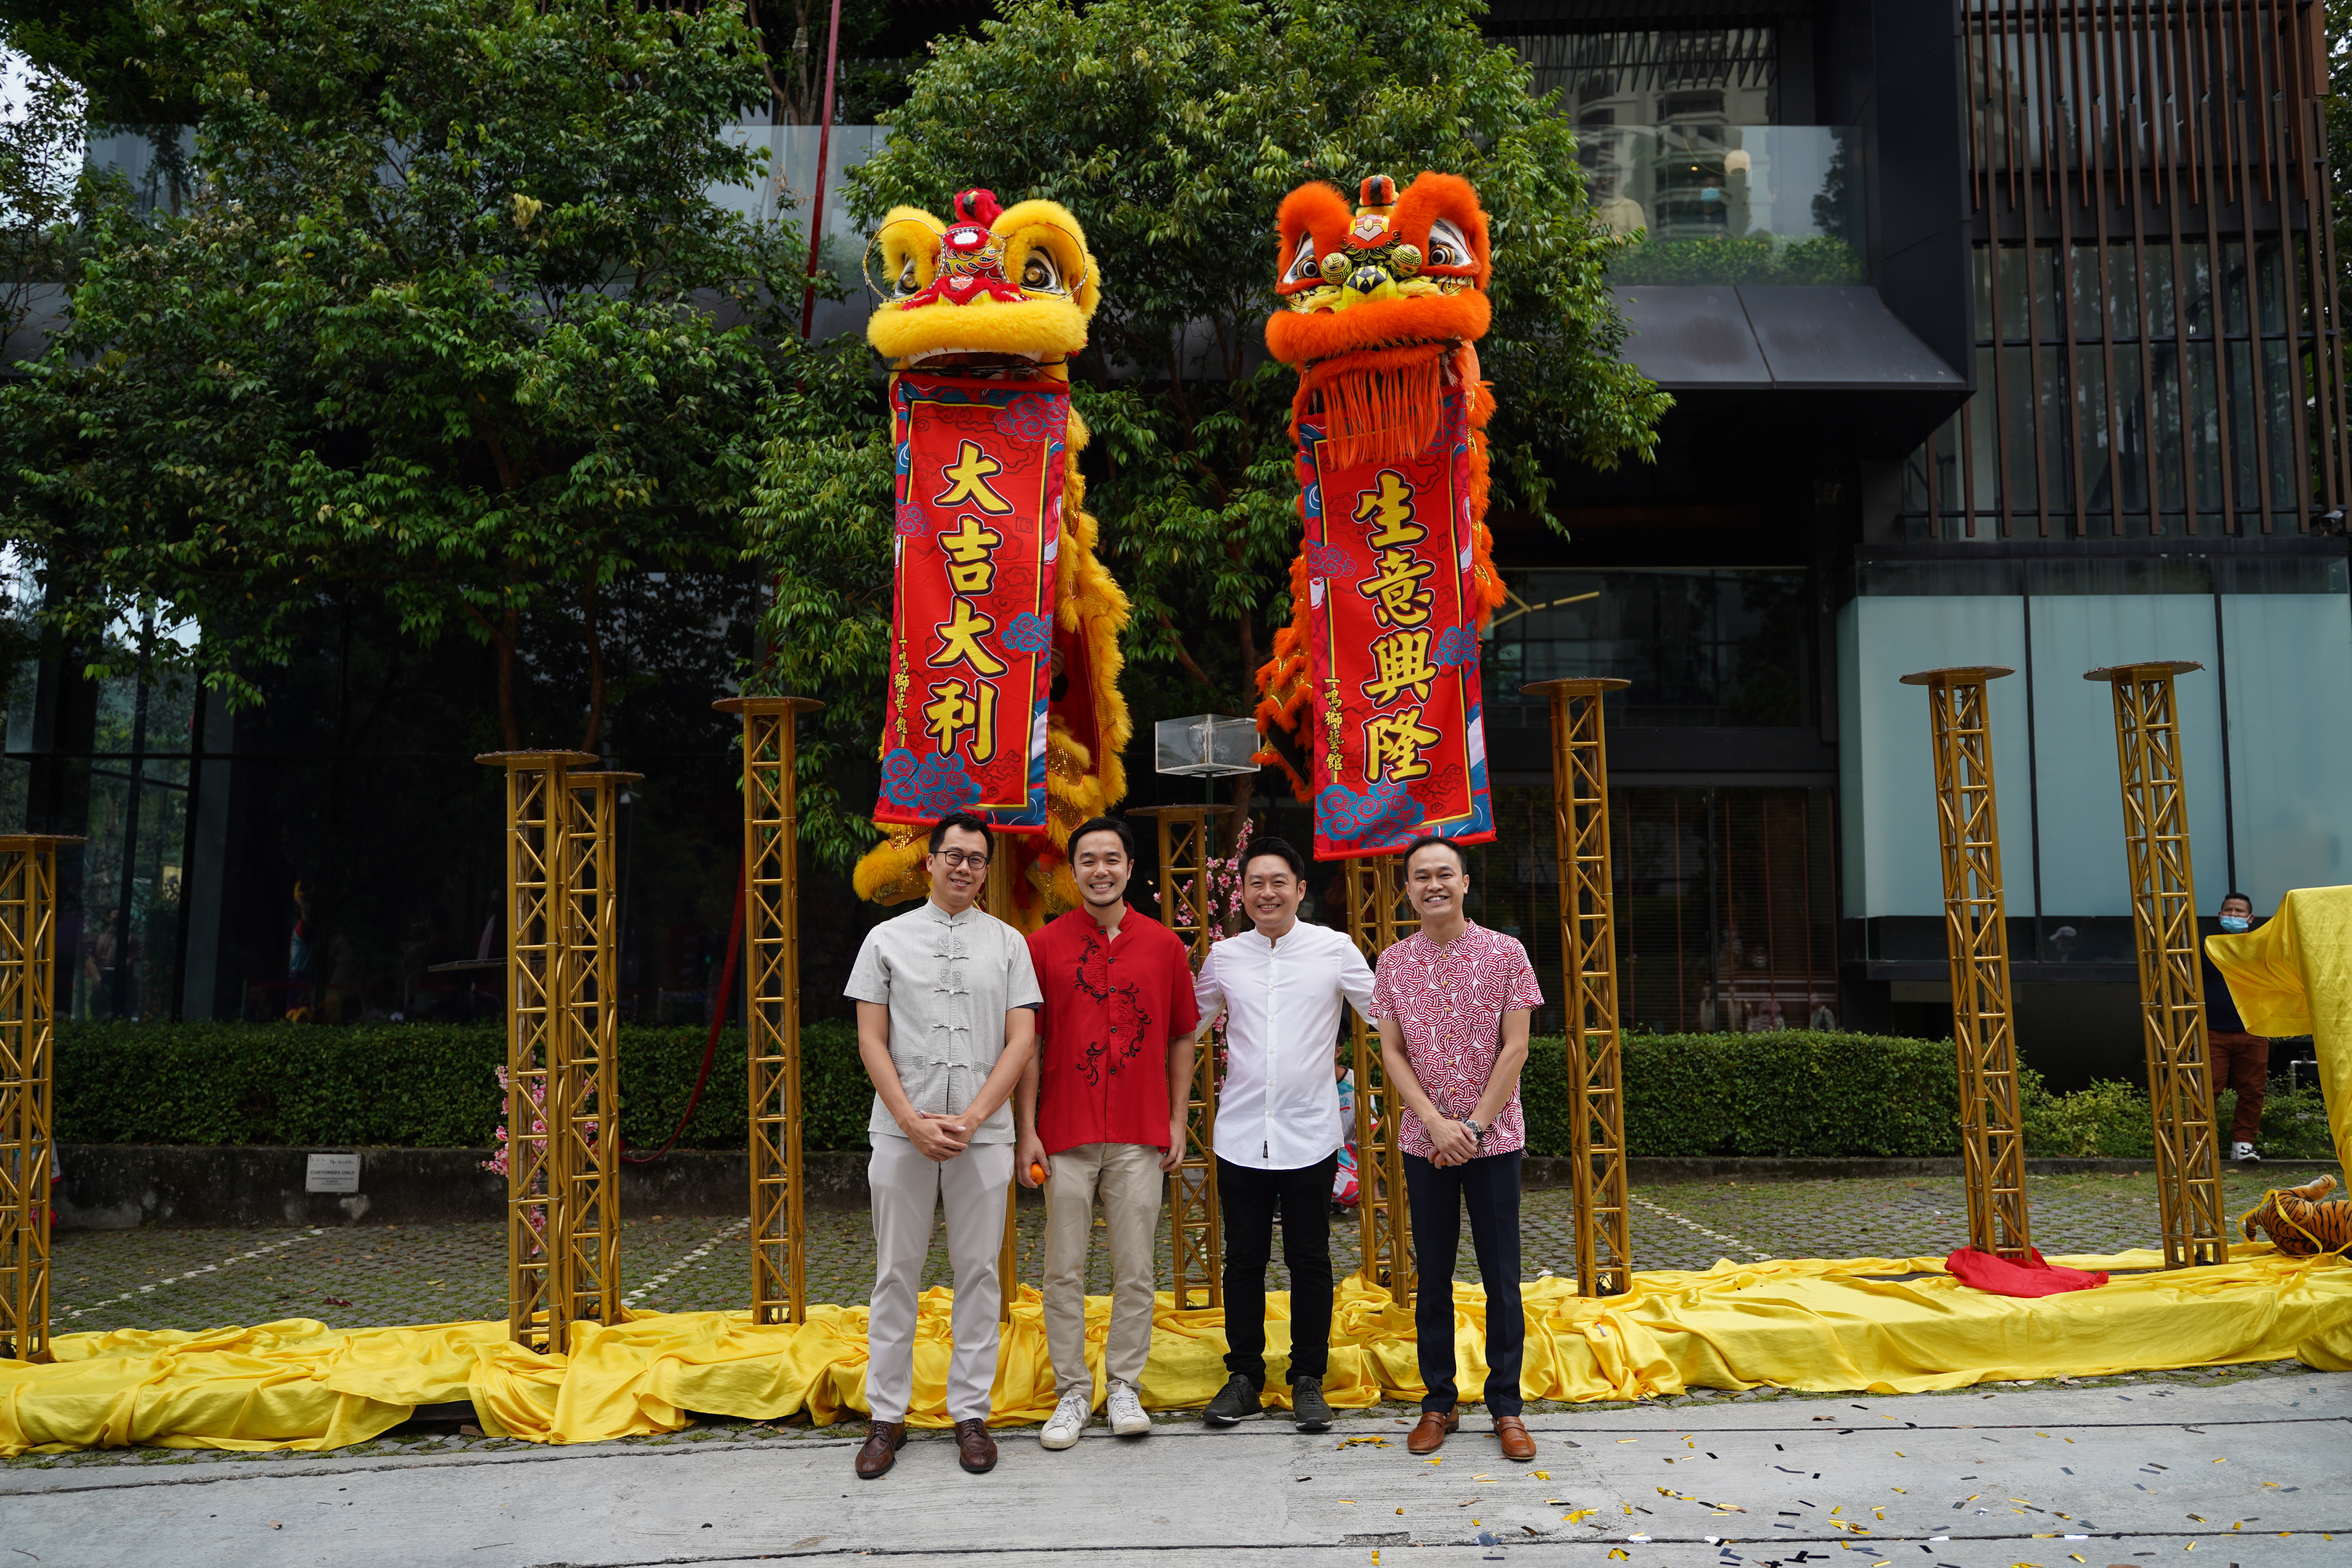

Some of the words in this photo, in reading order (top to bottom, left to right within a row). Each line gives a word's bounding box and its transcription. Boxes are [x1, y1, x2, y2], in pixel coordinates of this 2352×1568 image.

[894, 638, 910, 735] 一鳴獅藝館
[922, 439, 1014, 766] 大吉大利
[1353, 469, 1443, 785] 生意興隆
[1324, 678, 1345, 771] 一鳴獅藝館
